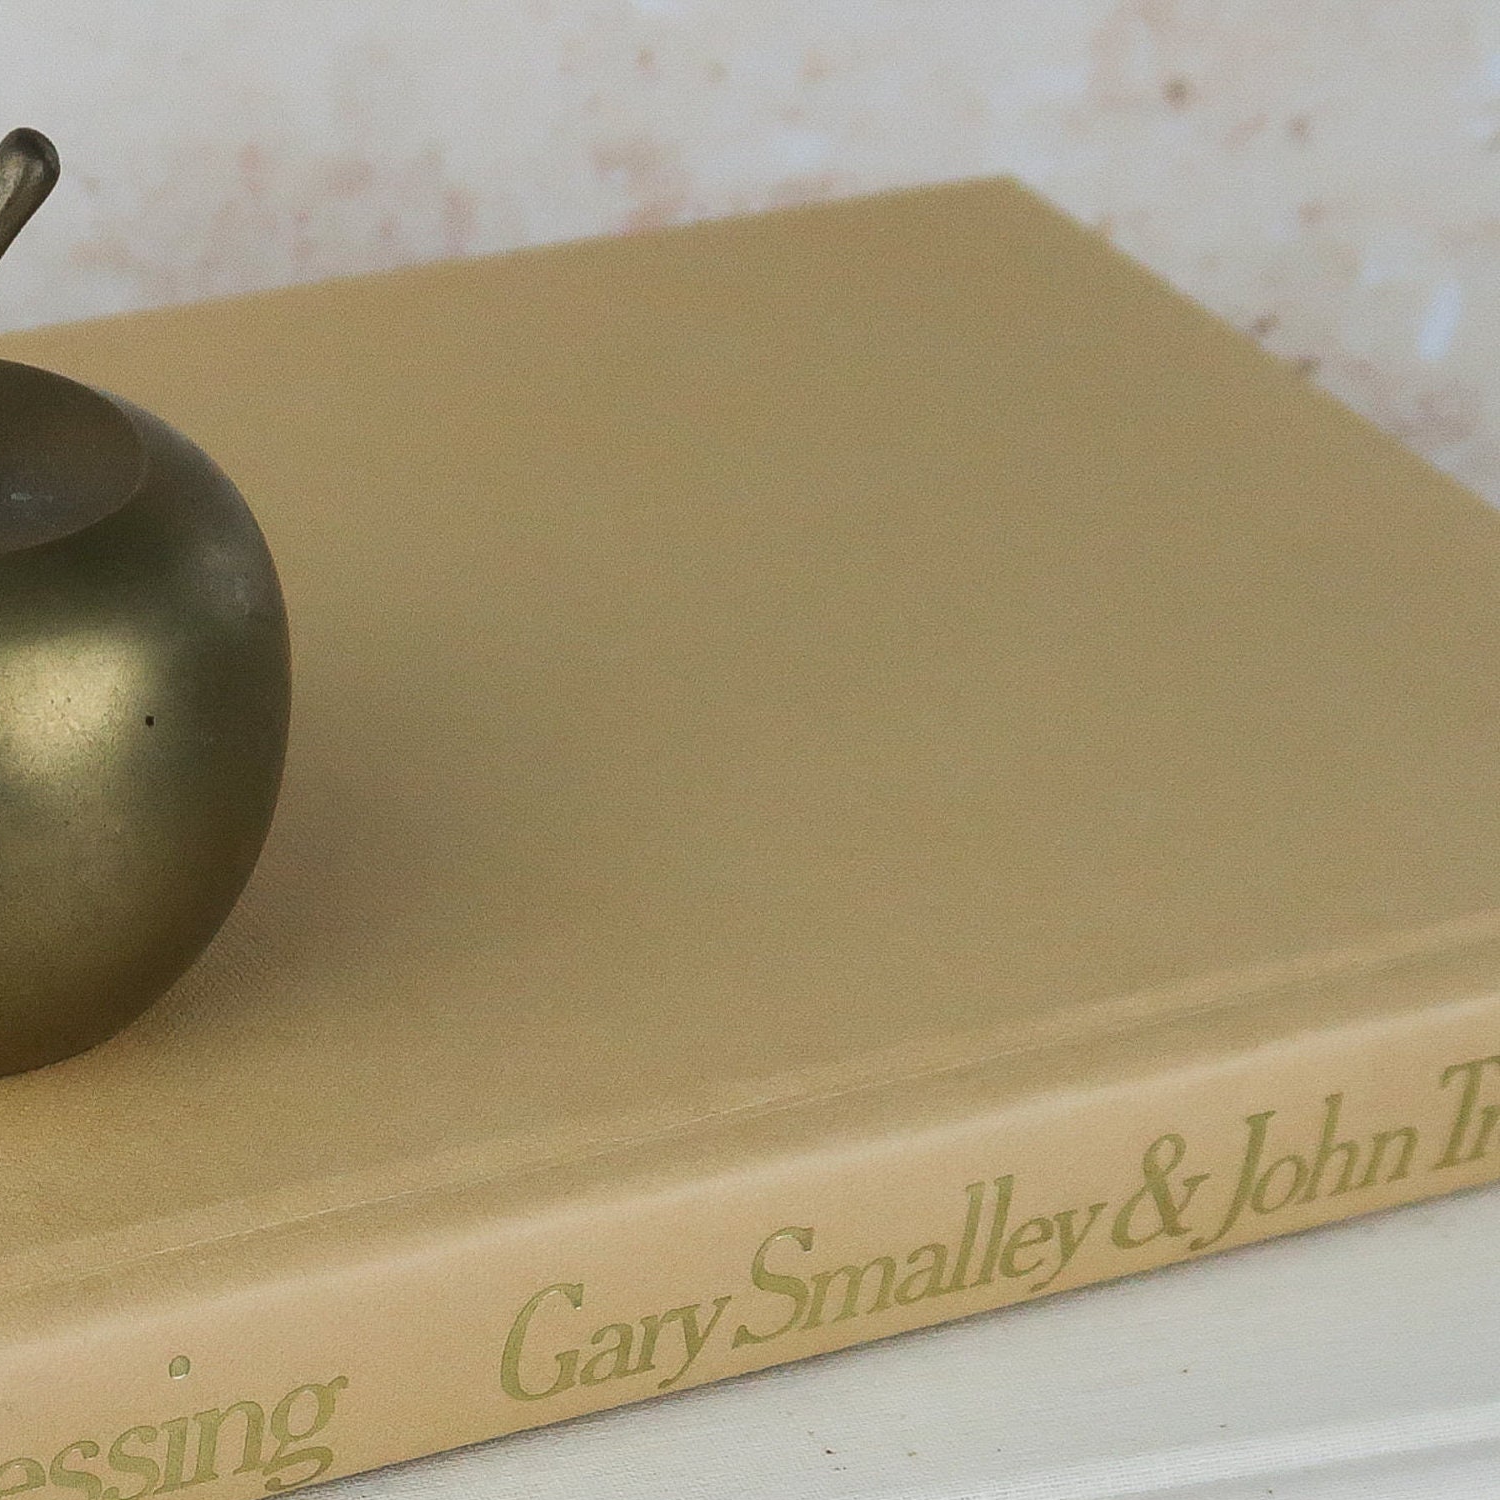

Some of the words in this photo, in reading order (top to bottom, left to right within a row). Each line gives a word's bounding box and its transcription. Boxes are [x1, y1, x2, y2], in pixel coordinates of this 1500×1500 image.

[499, 1281, 734, 1402] Gary
[730, 1173, 1109, 1348] Smalley
[1111, 1132, 1211, 1251] &
[1190, 1092, 1419, 1254] John
